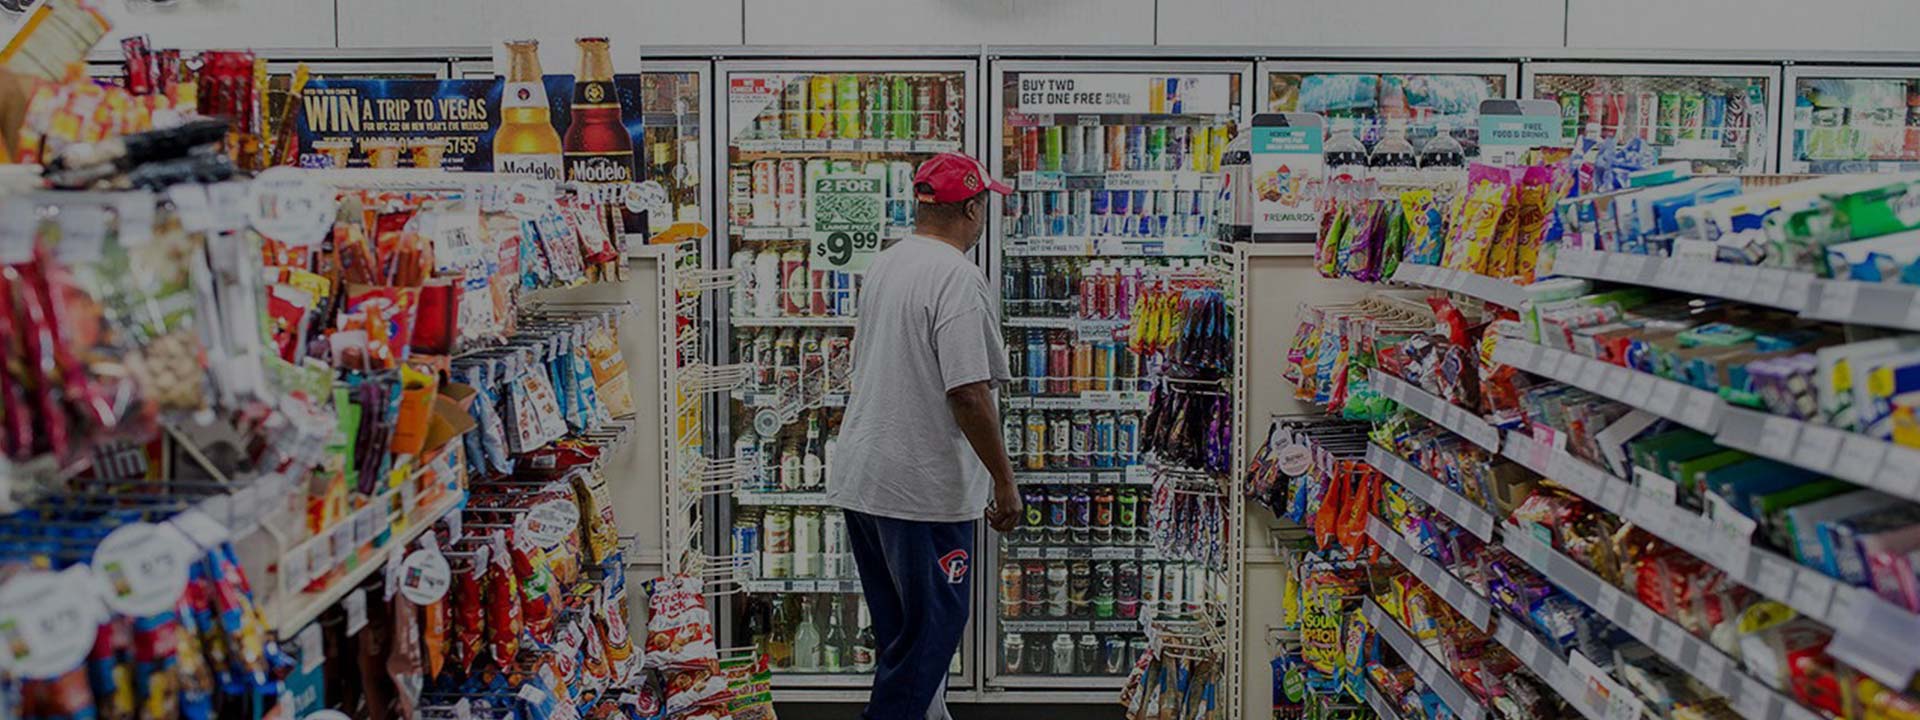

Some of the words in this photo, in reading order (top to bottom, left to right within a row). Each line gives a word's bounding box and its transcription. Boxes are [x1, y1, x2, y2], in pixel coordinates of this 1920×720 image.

[1022, 79, 1045, 91] BUY
[1048, 79, 1074, 91] TWO
[1022, 93, 1044, 105] GET
[1047, 93, 1070, 105] ONE
[1073, 93, 1102, 105] FREE
[303, 95, 361, 132] WIN
[362, 99, 374, 121] A
[376, 99, 411, 121] TRIP
[414, 99, 435, 121] TO
[438, 98, 488, 121] VEGAS
[1523, 122, 1544, 131] FREE
[1521, 130, 1549, 139] DRINKS
[573, 160, 626, 182] Modelo
[819, 180, 833, 192] 2
[835, 180, 874, 192] FOR
